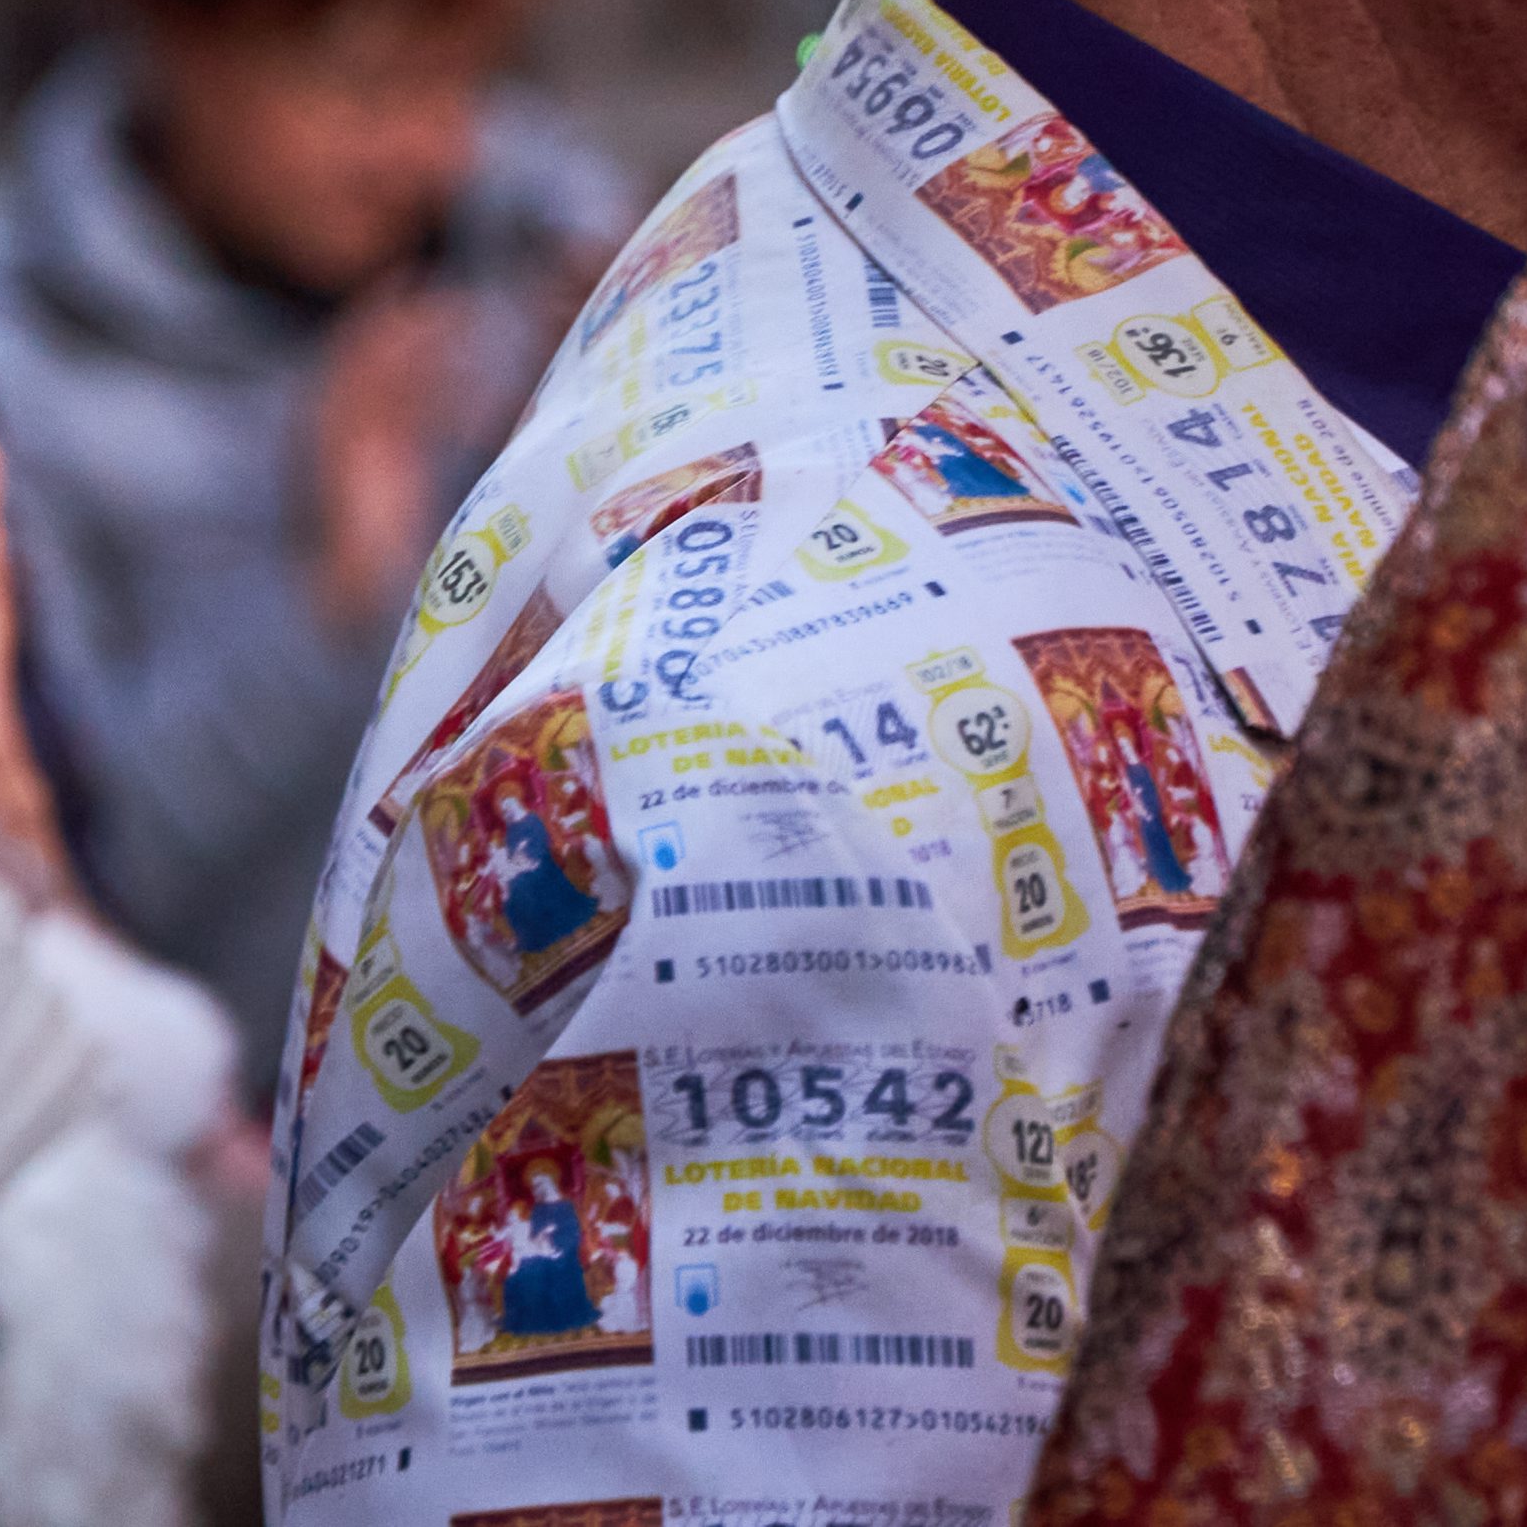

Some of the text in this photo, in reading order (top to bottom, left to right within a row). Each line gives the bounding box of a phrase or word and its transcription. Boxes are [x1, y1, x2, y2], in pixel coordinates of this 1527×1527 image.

[830, 34, 965, 161] 06954
[1241, 402, 1334, 523] NACIONAL
[1293, 432, 1376, 549] NAVIDAD
[811, 523, 858, 551] 20
[639, 790, 665, 810] 22
[674, 783, 701, 800] de
[708, 778, 820, 797] diciembre
[1014, 873, 1048, 913] 20
[382, 1025, 430, 1073] 20
[672, 1064, 975, 1131] 10542
[663, 1152, 971, 1187] LOTERÍA NACIONAL
[721, 1187, 922, 1214] DE NAVIDAD
[682, 1222, 961, 1248] 22 de diciembre de 2018
[1025, 1293, 1064, 1330] 20
[354, 1336, 386, 1374] 20
